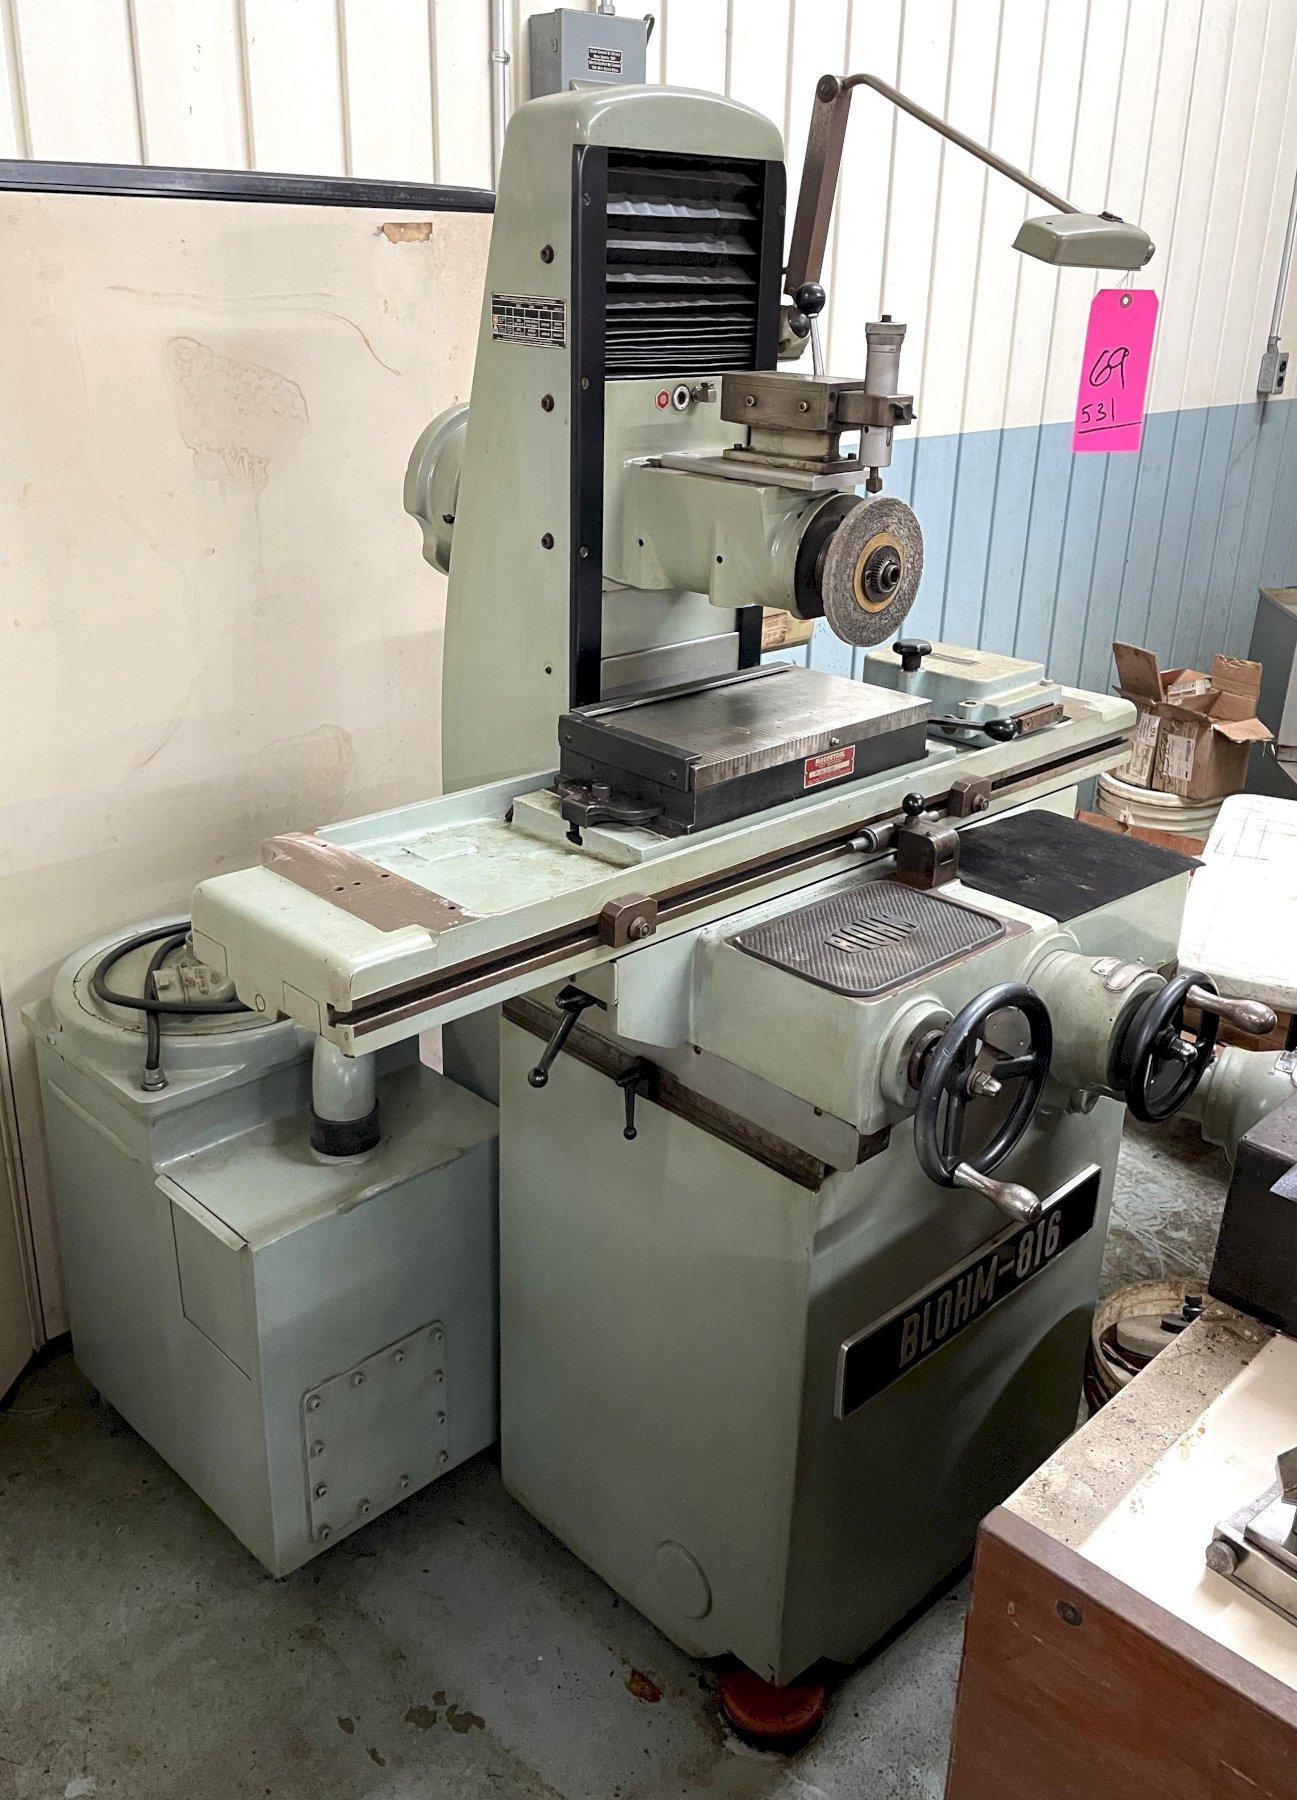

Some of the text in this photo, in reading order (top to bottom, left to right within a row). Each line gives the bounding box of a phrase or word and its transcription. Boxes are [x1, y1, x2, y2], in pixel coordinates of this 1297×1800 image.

[1089, 346, 1130, 390] 69
[1081, 397, 1115, 424] 531
[899, 1209, 1062, 1369] BLOHM-816
